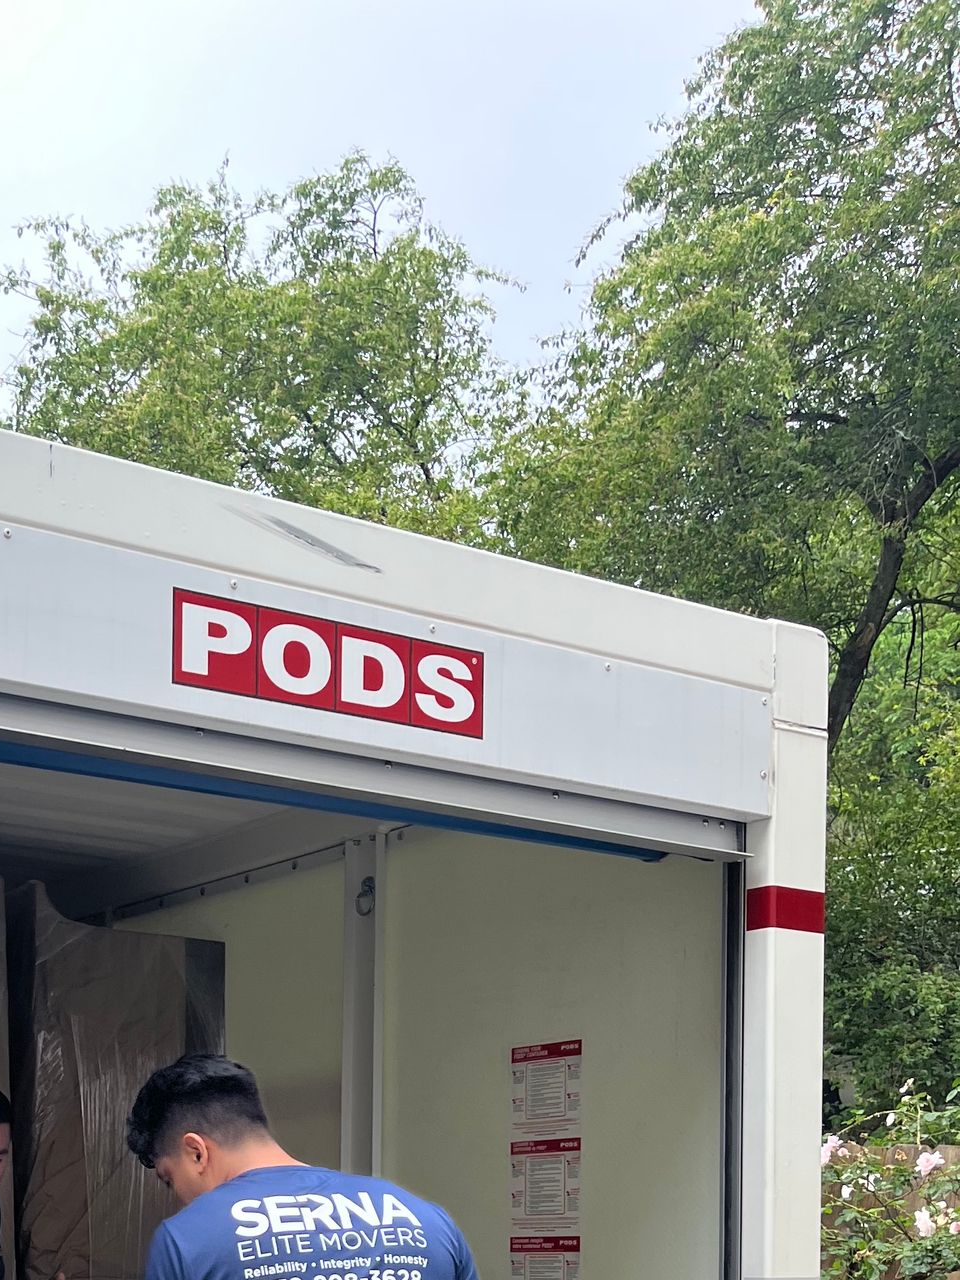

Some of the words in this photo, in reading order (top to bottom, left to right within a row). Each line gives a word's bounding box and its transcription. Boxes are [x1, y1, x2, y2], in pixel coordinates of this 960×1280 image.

[181, 601, 476, 723] PODS
[230, 1191, 423, 1237] SERNA
[237, 1233, 314, 1262] ELITE
[319, 1227, 427, 1252] MOVERS
[243, 1261, 308, 1280] Reliability
[319, 1256, 372, 1270] Integrity
[383, 1253, 428, 1268] Honesty
